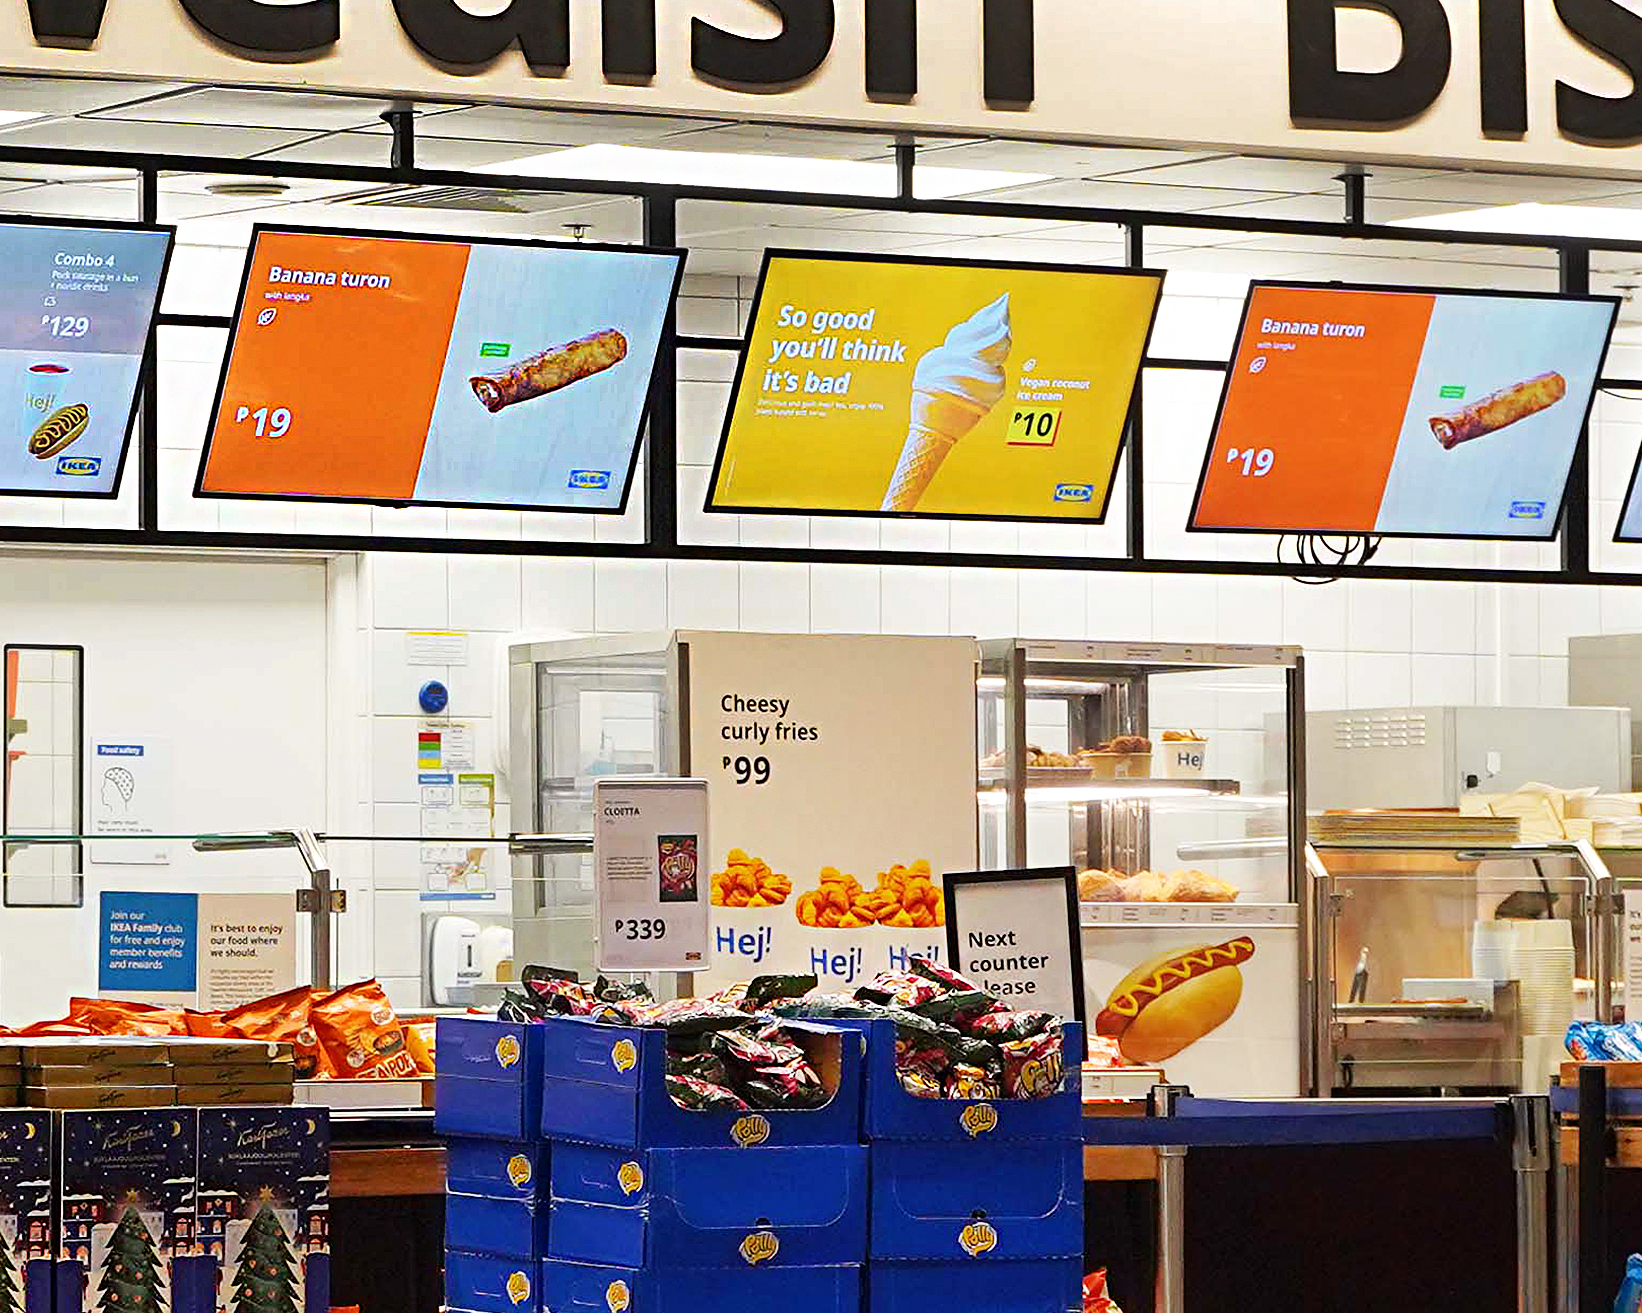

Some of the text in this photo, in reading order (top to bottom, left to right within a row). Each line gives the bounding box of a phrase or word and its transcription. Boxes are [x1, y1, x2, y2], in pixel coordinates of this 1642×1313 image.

[54, 252, 115, 268] Combo 4
[268, 266, 391, 289] Banana turon
[777, 304, 874, 335] So good
[1261, 318, 1365, 338] Banana turon
[768, 338, 906, 365] you'll think
[763, 368, 851, 395] it's bad
[1020, 377, 1090, 390] Vegan coconut
[1017, 390, 1063, 401] ice cream
[59, 460, 98, 473] IKEA
[1058, 487, 1090, 500] IKEA
[721, 694, 789, 718] Cheesy
[721, 721, 819, 745] curly fries
[110, 911, 145, 921] Join our
[110, 924, 183, 936] IKEA Family club
[210, 924, 283, 936] It's best to enjoy
[110, 935, 185, 948] for free and enjoy
[210, 936, 278, 945] our food where
[716, 926, 772, 963] Hej!
[968, 931, 1016, 949] Next
[110, 947, 183, 958] member benefits
[210, 948, 258, 957] we should.
[109, 960, 163, 970] and rewards
[810, 947, 862, 983] Hej!
[970, 955, 1049, 973] counter
[979, 979, 1036, 996] lease
[963, 1104, 998, 1137] Polly
[960, 1223, 998, 1256] Polly
